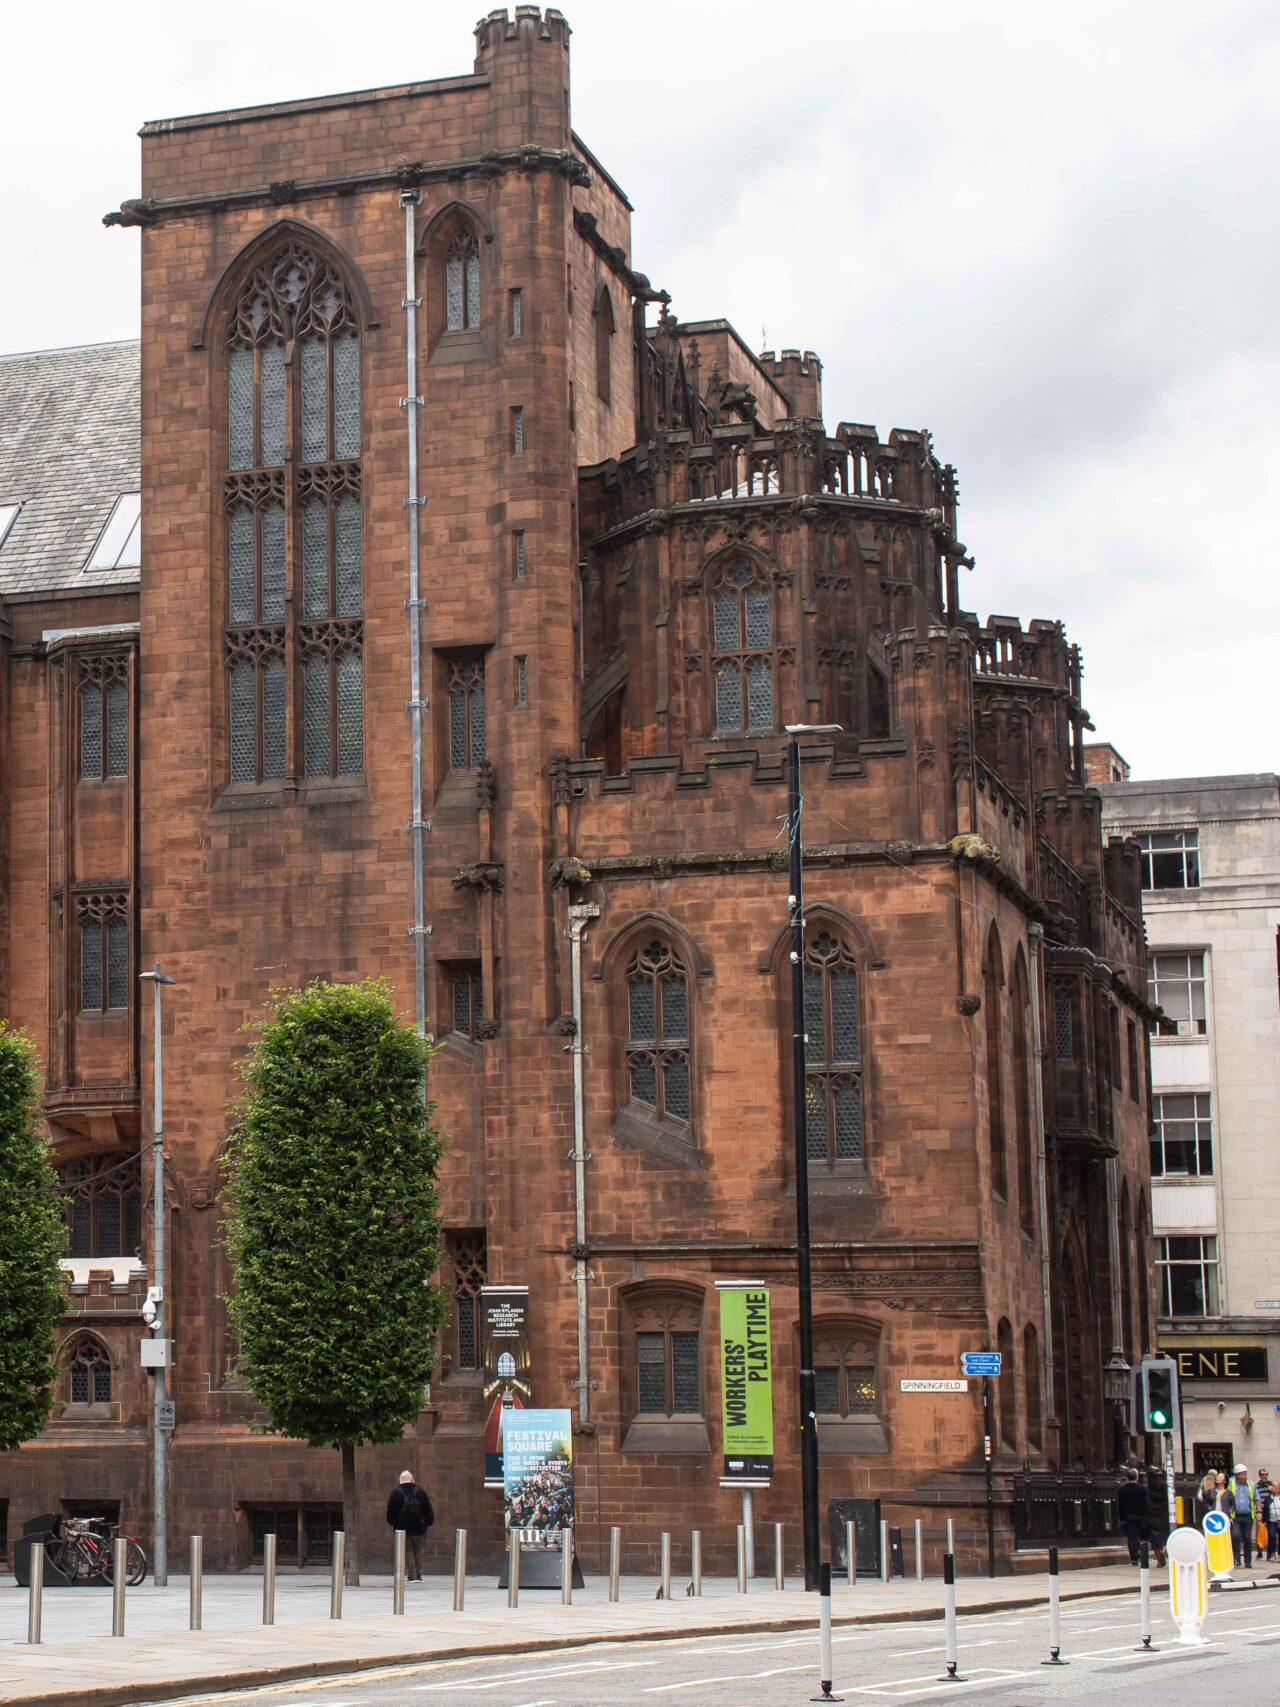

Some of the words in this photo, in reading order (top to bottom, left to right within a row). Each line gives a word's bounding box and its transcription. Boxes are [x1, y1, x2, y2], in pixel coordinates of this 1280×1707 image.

[746, 1293, 768, 1382] PLAYTIME
[1165, 1353, 1240, 1377] ENE
[724, 1339, 747, 1427] WORKERS'
[902, 1382, 961, 1390] SPINNINGFIELD
[506, 1430, 567, 1441] FESTIVAL
[507, 1441, 553, 1452] SQUARE
